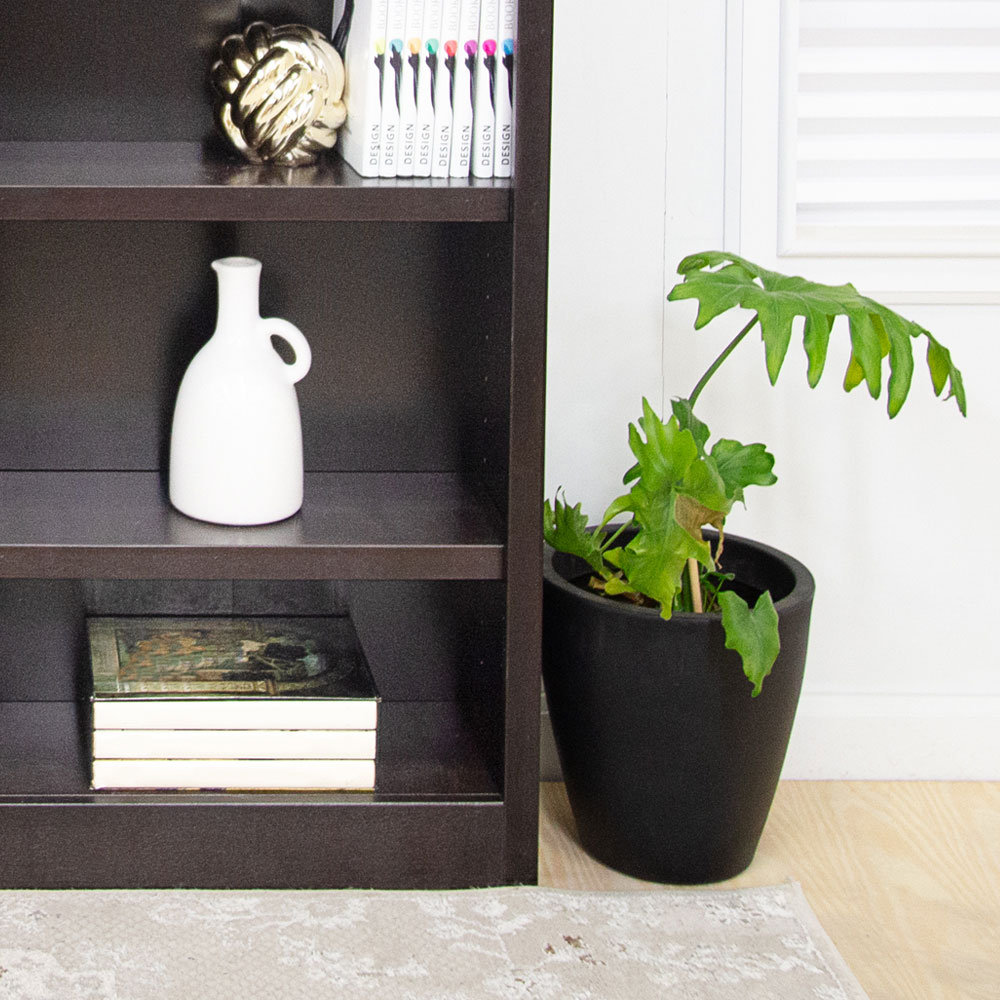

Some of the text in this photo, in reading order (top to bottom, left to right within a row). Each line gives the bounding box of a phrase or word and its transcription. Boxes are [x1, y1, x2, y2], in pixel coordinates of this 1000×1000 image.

[468, 0, 479, 30] BOOK
[503, 0, 514, 30] BOOK
[369, 124, 379, 165] DESIGN
[384, 124, 395, 165] DESIGN
[404, 124, 414, 165] DESIGN
[419, 124, 430, 165] DESIGN
[438, 125, 449, 166] DESIGN
[460, 125, 470, 166] DESIGN
[481, 125, 491, 166] DESIGN
[501, 124, 511, 166] DESIGN
